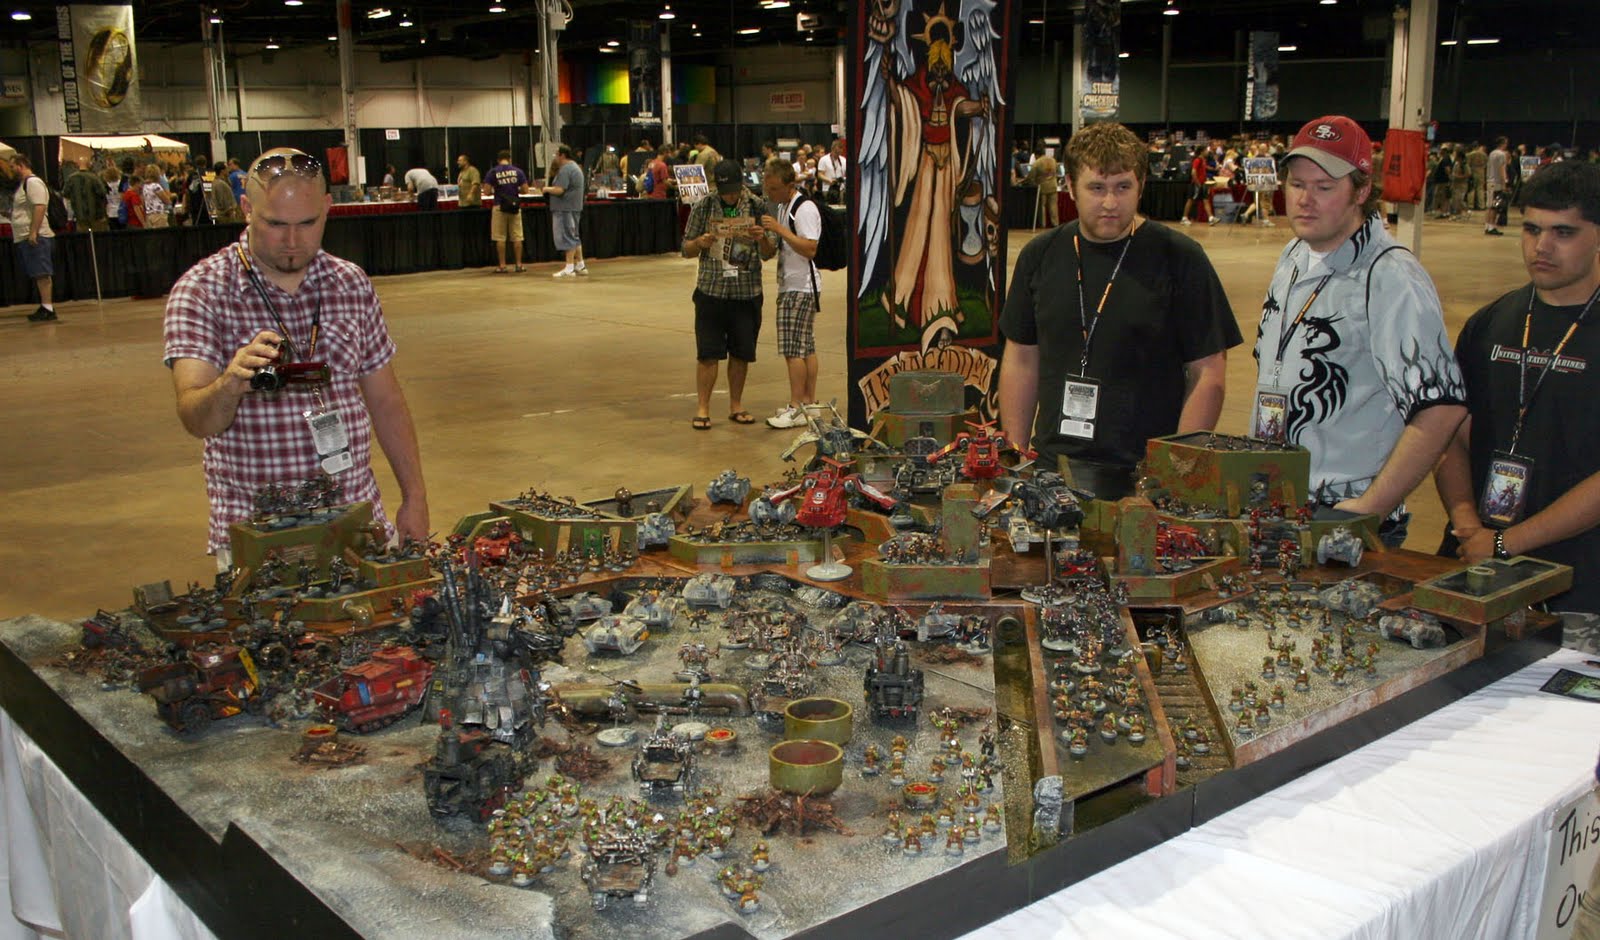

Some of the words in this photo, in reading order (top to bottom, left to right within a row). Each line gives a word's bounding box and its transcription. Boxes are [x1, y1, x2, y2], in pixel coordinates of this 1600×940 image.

[56, 5, 72, 39] RINGS
[60, 42, 74, 62] THE
[62, 63, 75, 78] OF
[63, 81, 79, 109] LORD
[1083, 94, 1119, 107] CHECKOUT
[67, 111, 81, 132] THE
[1558, 808, 1600, 867] This
